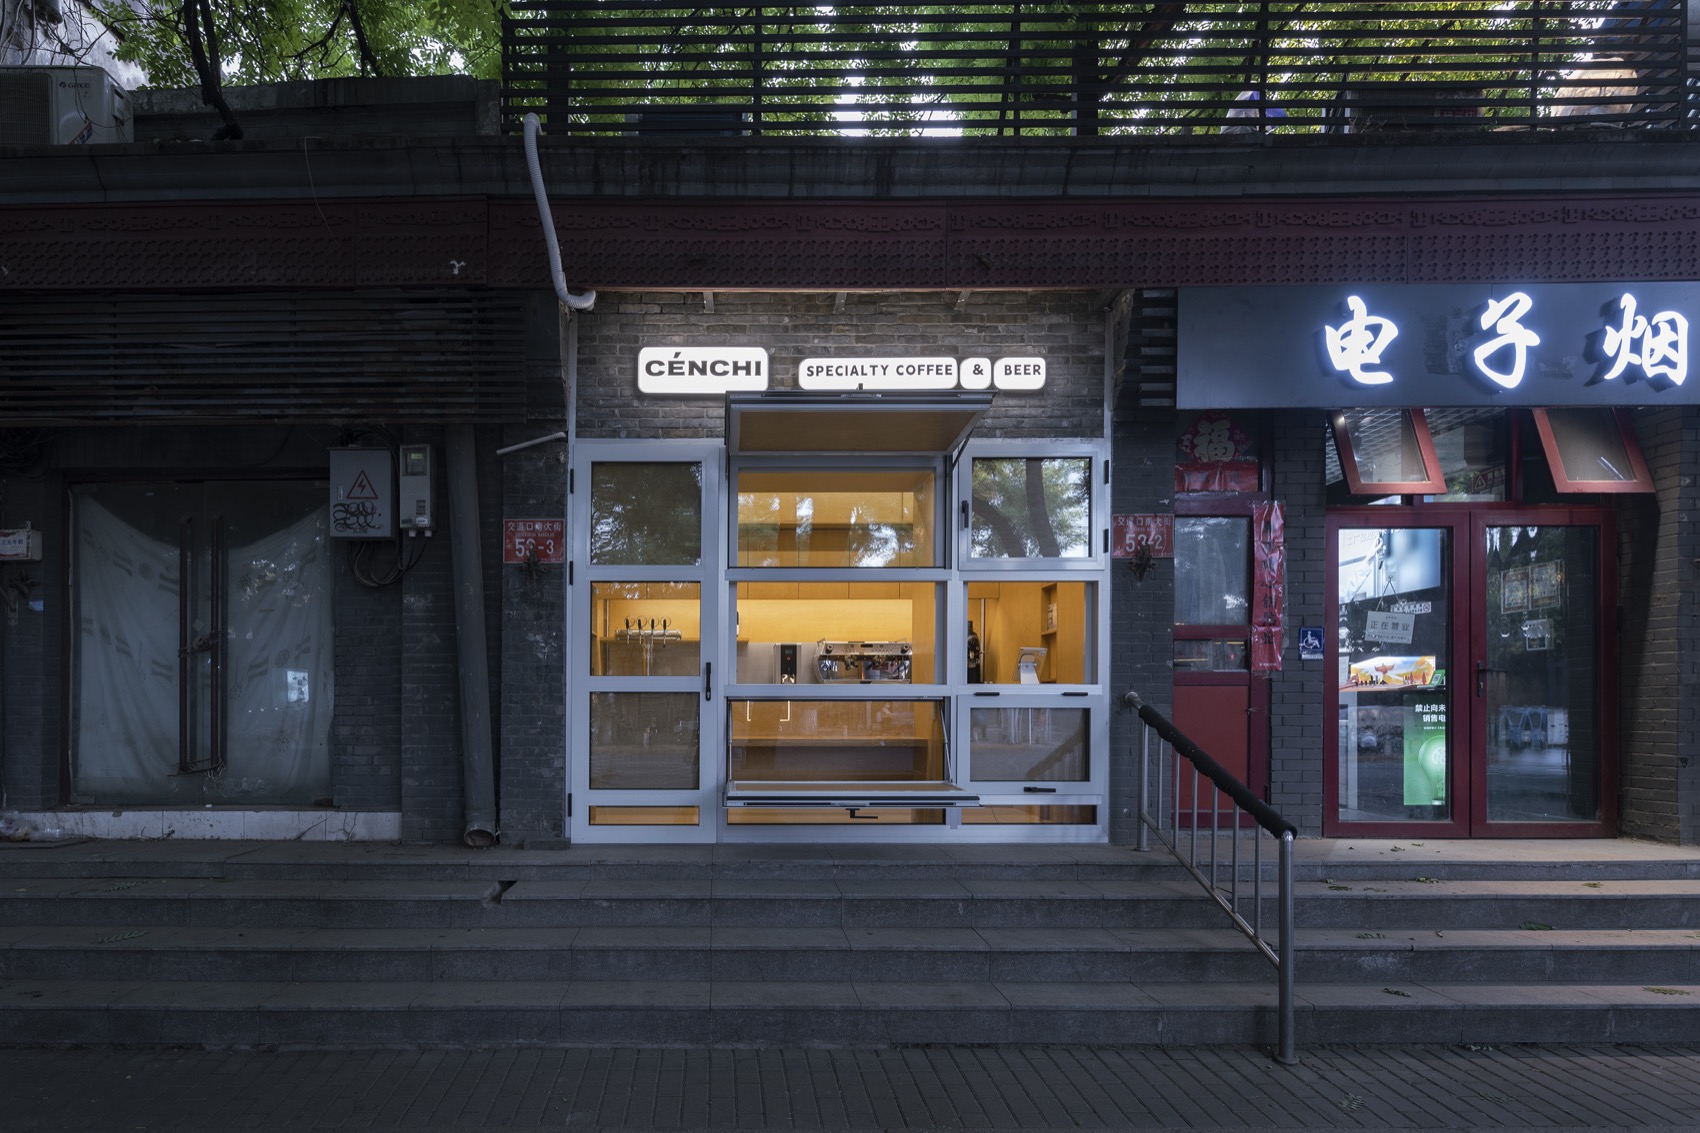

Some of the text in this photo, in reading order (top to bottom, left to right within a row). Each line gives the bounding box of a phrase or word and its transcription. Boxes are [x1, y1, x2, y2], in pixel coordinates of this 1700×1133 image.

[1325, 291, 1689, 389] 电子烟
[645, 351, 762, 377] CÉNCHI
[806, 363, 1042, 377] SPECIALTY COFFEE & BEER
[1193, 419, 1236, 463] 福
[1370, 620, 1410, 631] 正在营业
